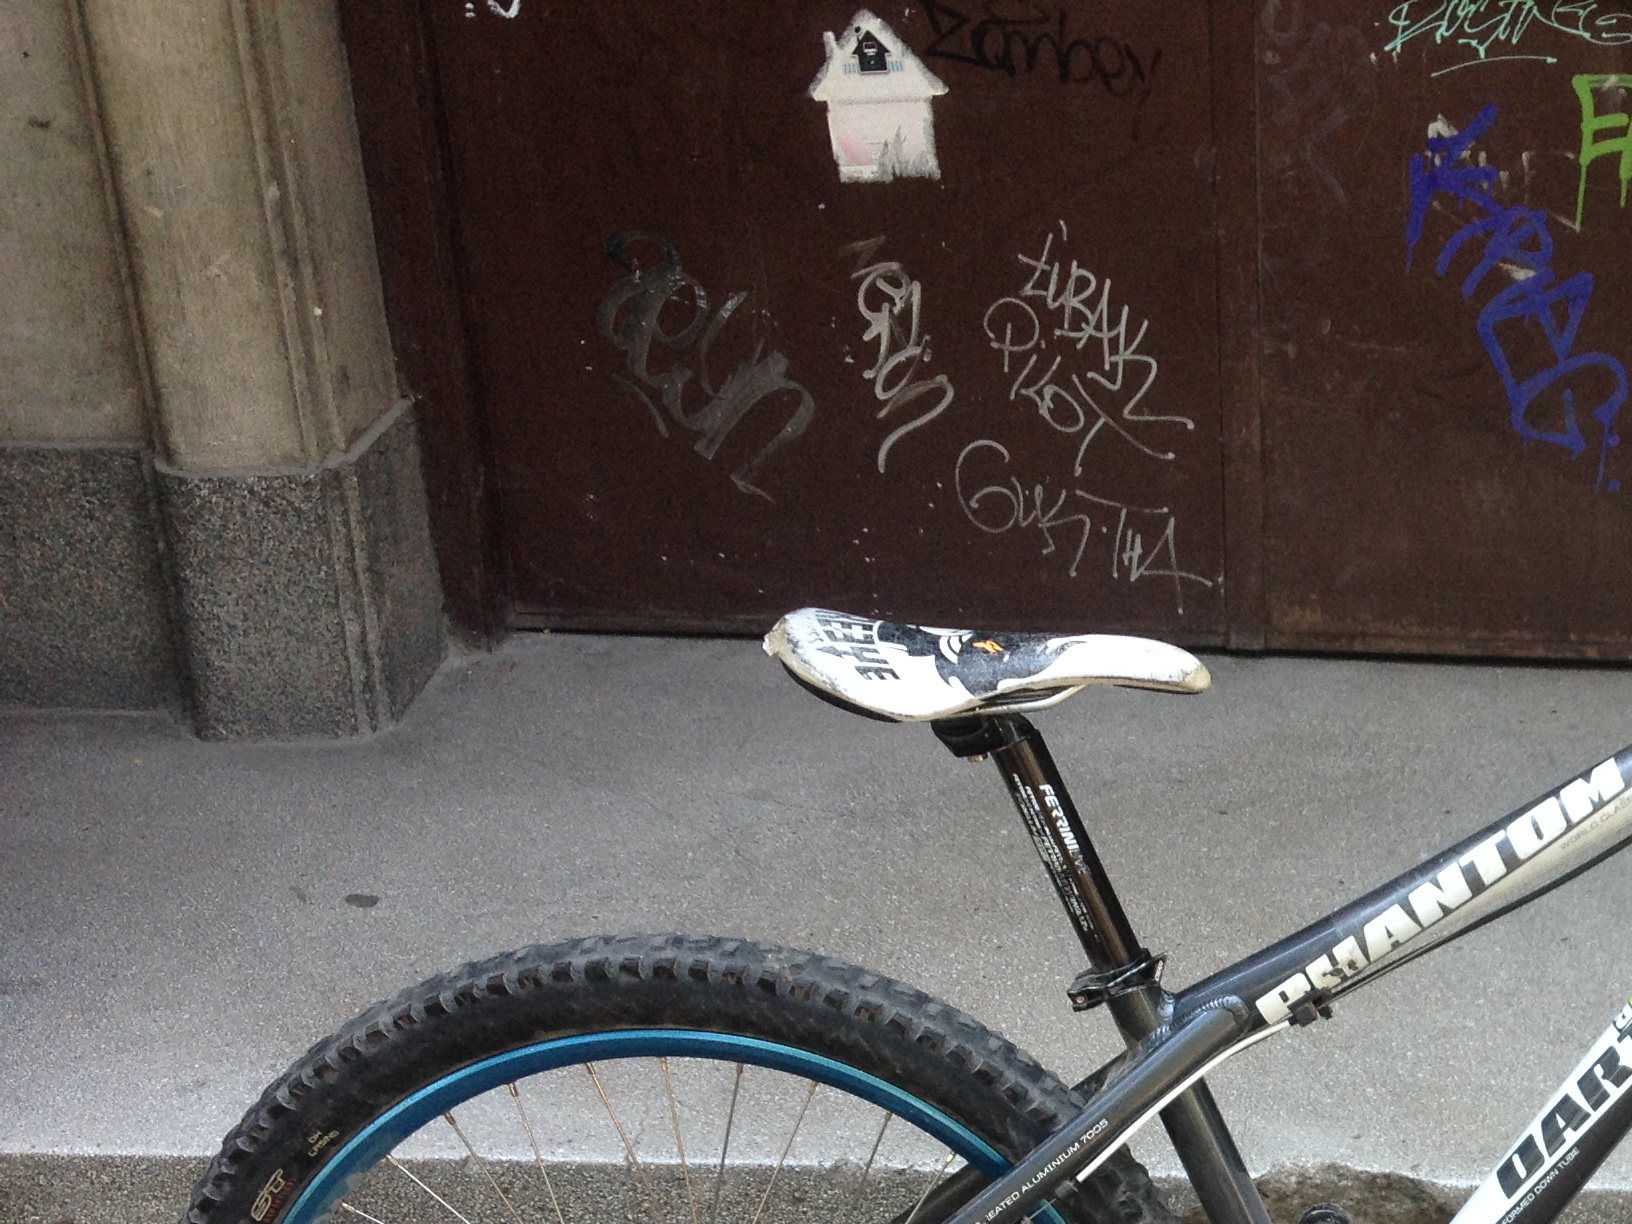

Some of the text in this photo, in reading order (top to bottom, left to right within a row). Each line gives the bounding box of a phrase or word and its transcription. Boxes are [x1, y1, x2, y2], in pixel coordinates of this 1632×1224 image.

[1021, 1141, 1081, 1195] ALUMINIUM
[1079, 1117, 1110, 1145] 7005
[1533, 1168, 1559, 1195] DOWN
[1557, 1146, 1581, 1170] TUBE
